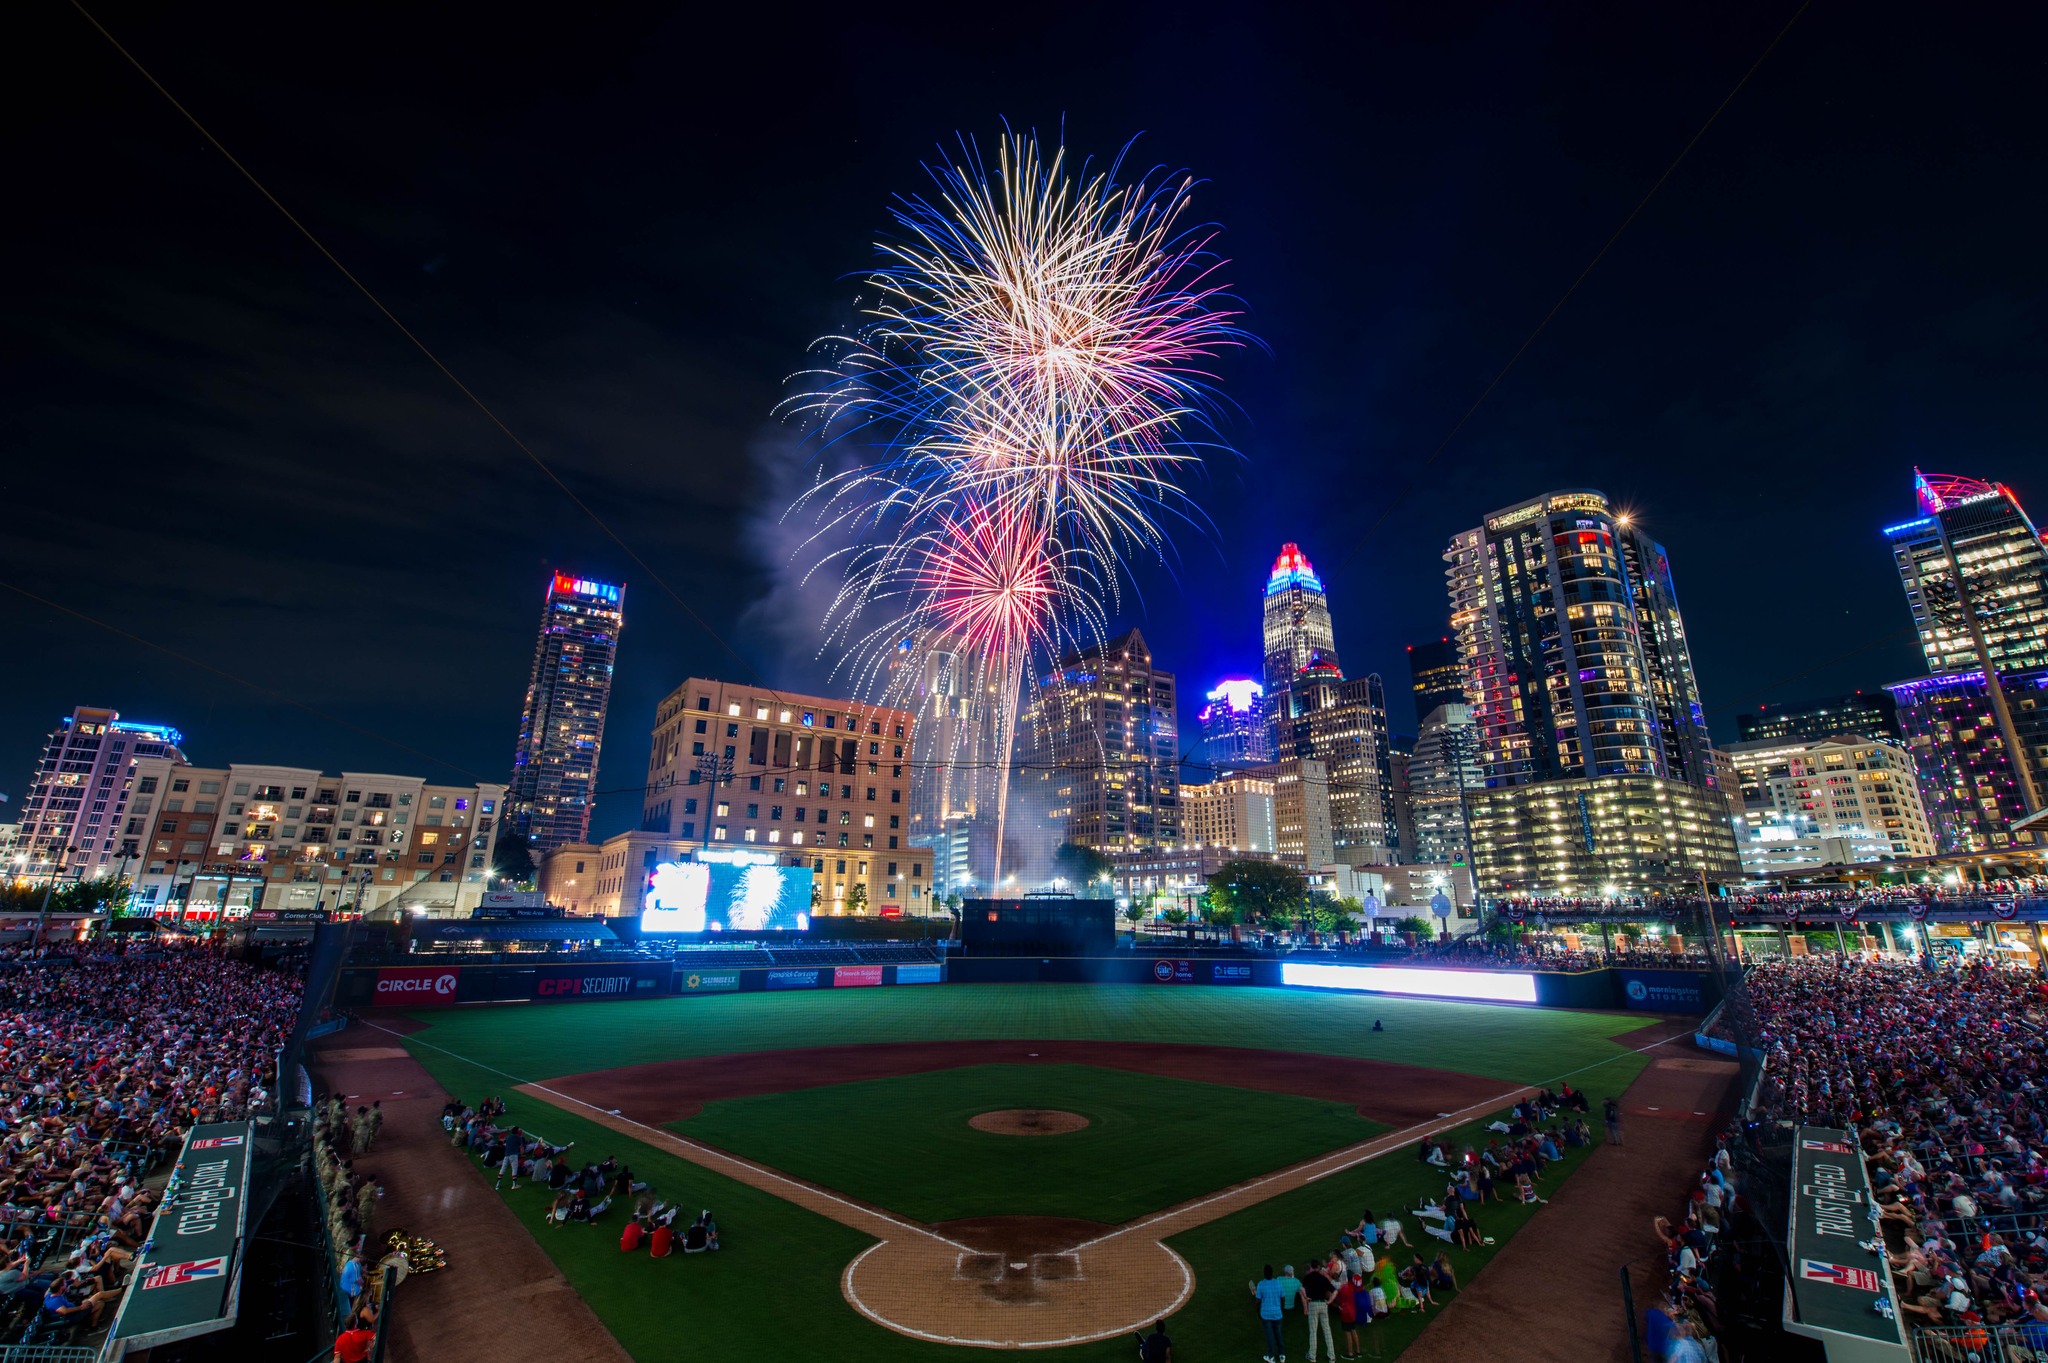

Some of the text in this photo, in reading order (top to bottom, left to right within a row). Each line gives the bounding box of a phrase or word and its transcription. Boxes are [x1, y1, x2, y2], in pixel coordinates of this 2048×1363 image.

[1962, 490, 2000, 505] BARINGS
[377, 979, 432, 992] CIRCLE
[538, 976, 631, 995] CPI SECURITY
[702, 976, 736, 984] SUNBELT
[1649, 986, 1701, 996] morningstar
[1650, 994, 1700, 1002] STORAGE
[176, 1159, 229, 1236] TRUIST FIELD
[1813, 1164, 1855, 1238] TRUIST FIELD
